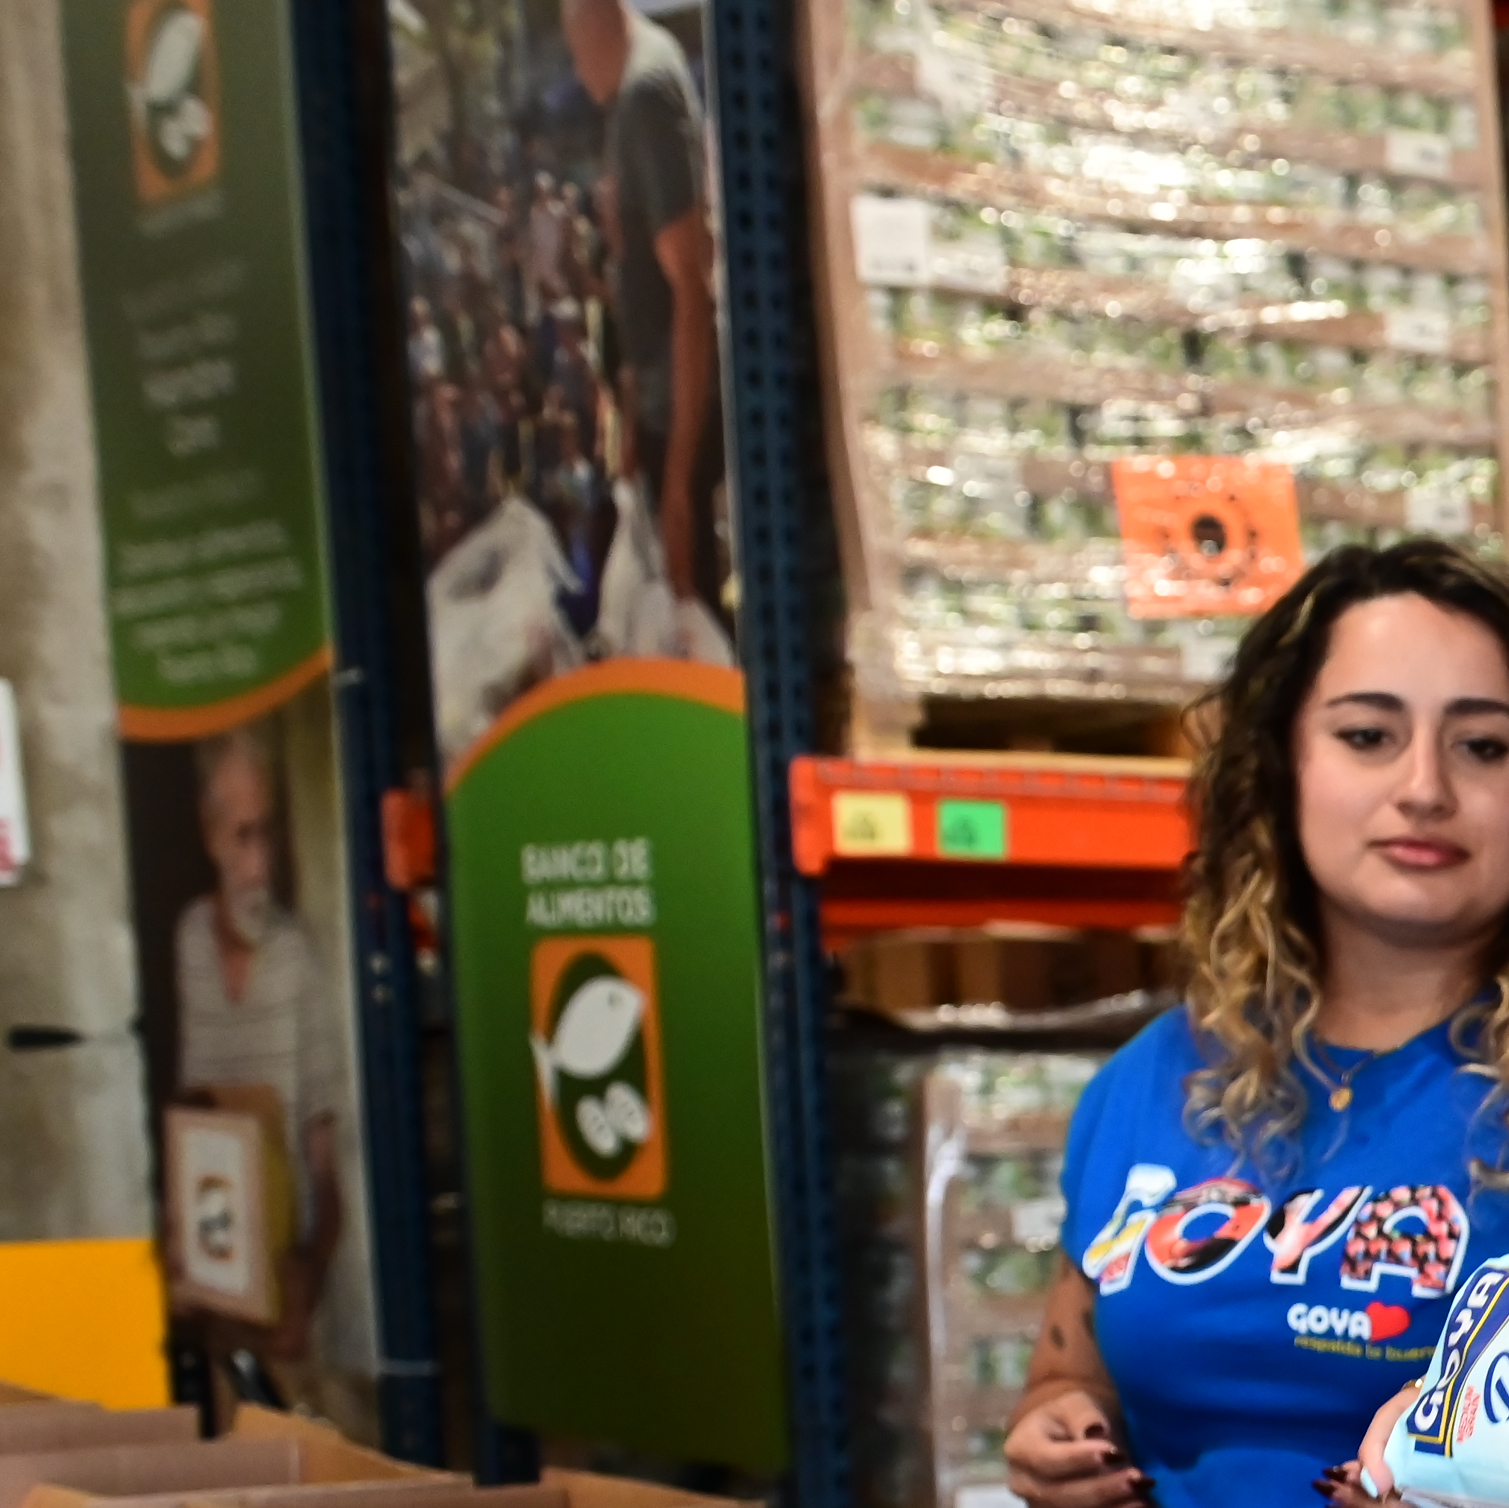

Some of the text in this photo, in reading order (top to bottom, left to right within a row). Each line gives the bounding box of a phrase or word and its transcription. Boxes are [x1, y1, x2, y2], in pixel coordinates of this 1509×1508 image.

[525, 885, 656, 927] ALIMENTOS
[1082, 1163, 1470, 1298] GOYA
[1287, 1302, 1372, 1341] GOYA
[1414, 1271, 1504, 1432] GOYA
